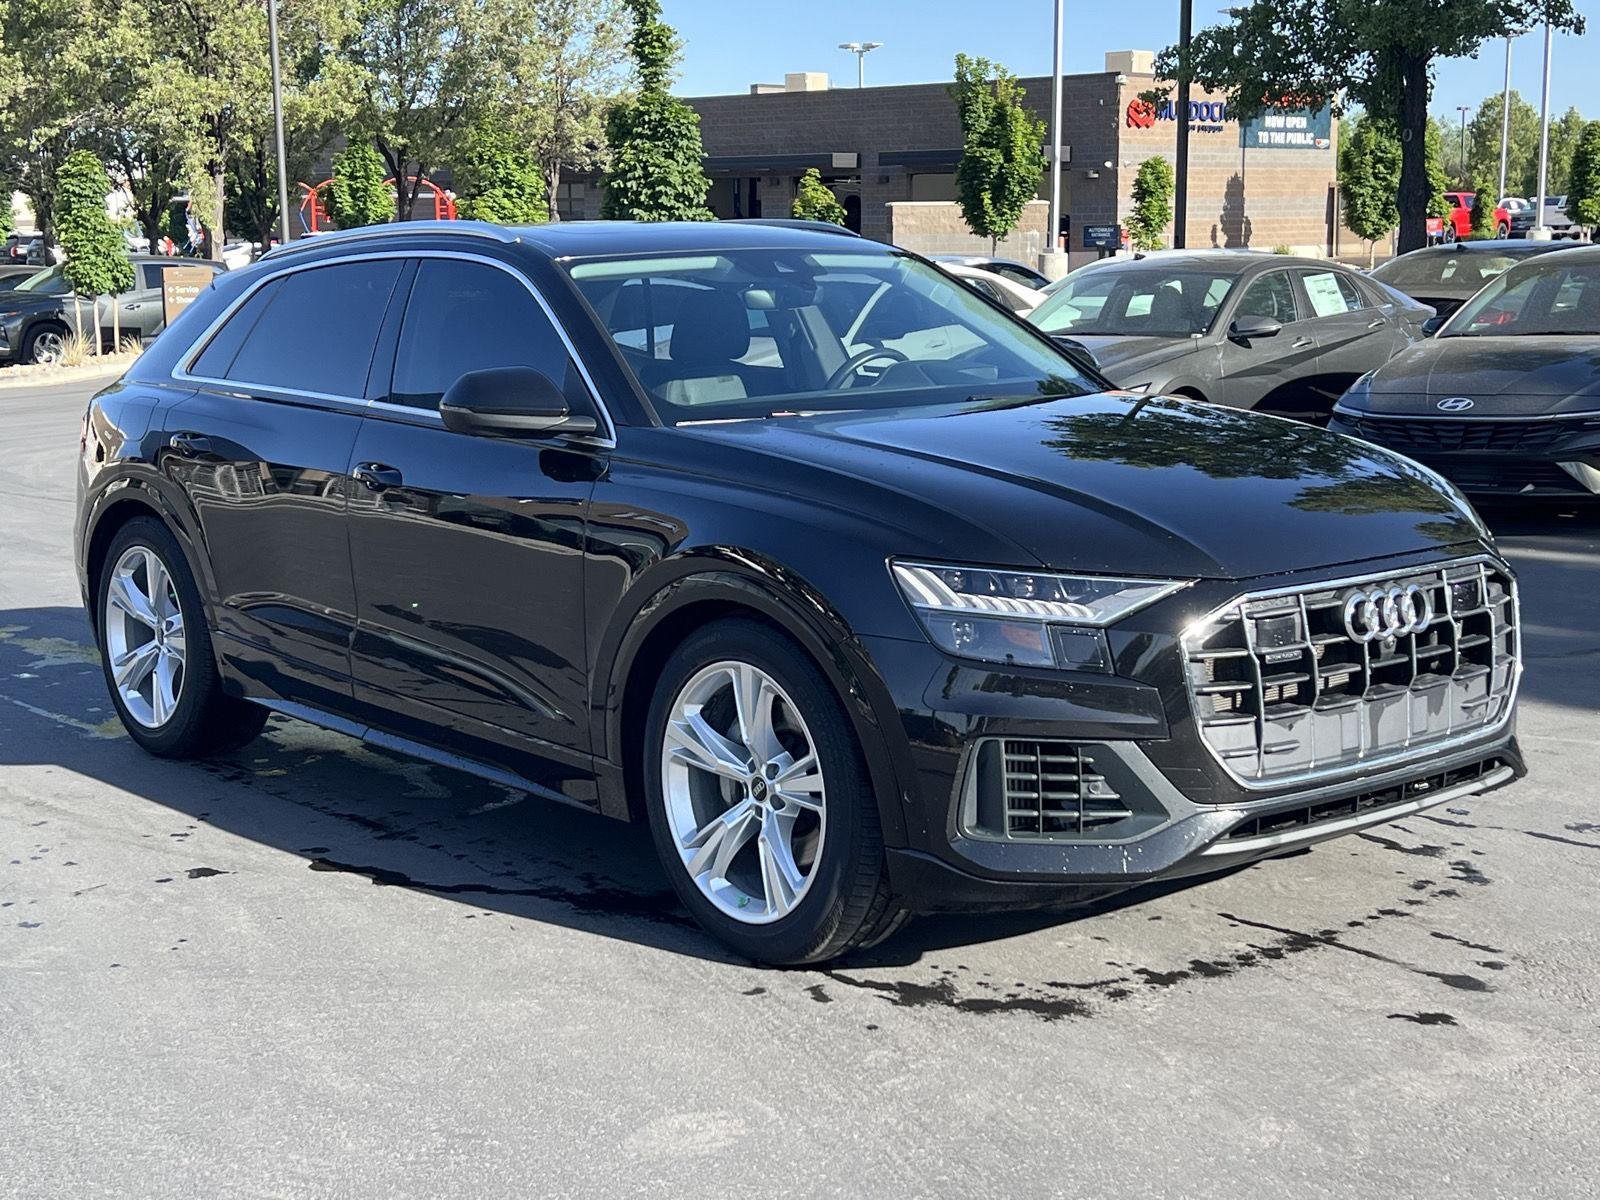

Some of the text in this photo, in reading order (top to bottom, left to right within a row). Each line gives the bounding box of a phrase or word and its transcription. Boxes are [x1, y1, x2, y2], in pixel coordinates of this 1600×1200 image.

[1265, 115, 1307, 129] NOW OPEN
[1258, 131, 1269, 144] TO
[1270, 131, 1285, 144] THE
[1286, 132, 1314, 145] PUBLIC
[175, 285, 200, 294] Service
